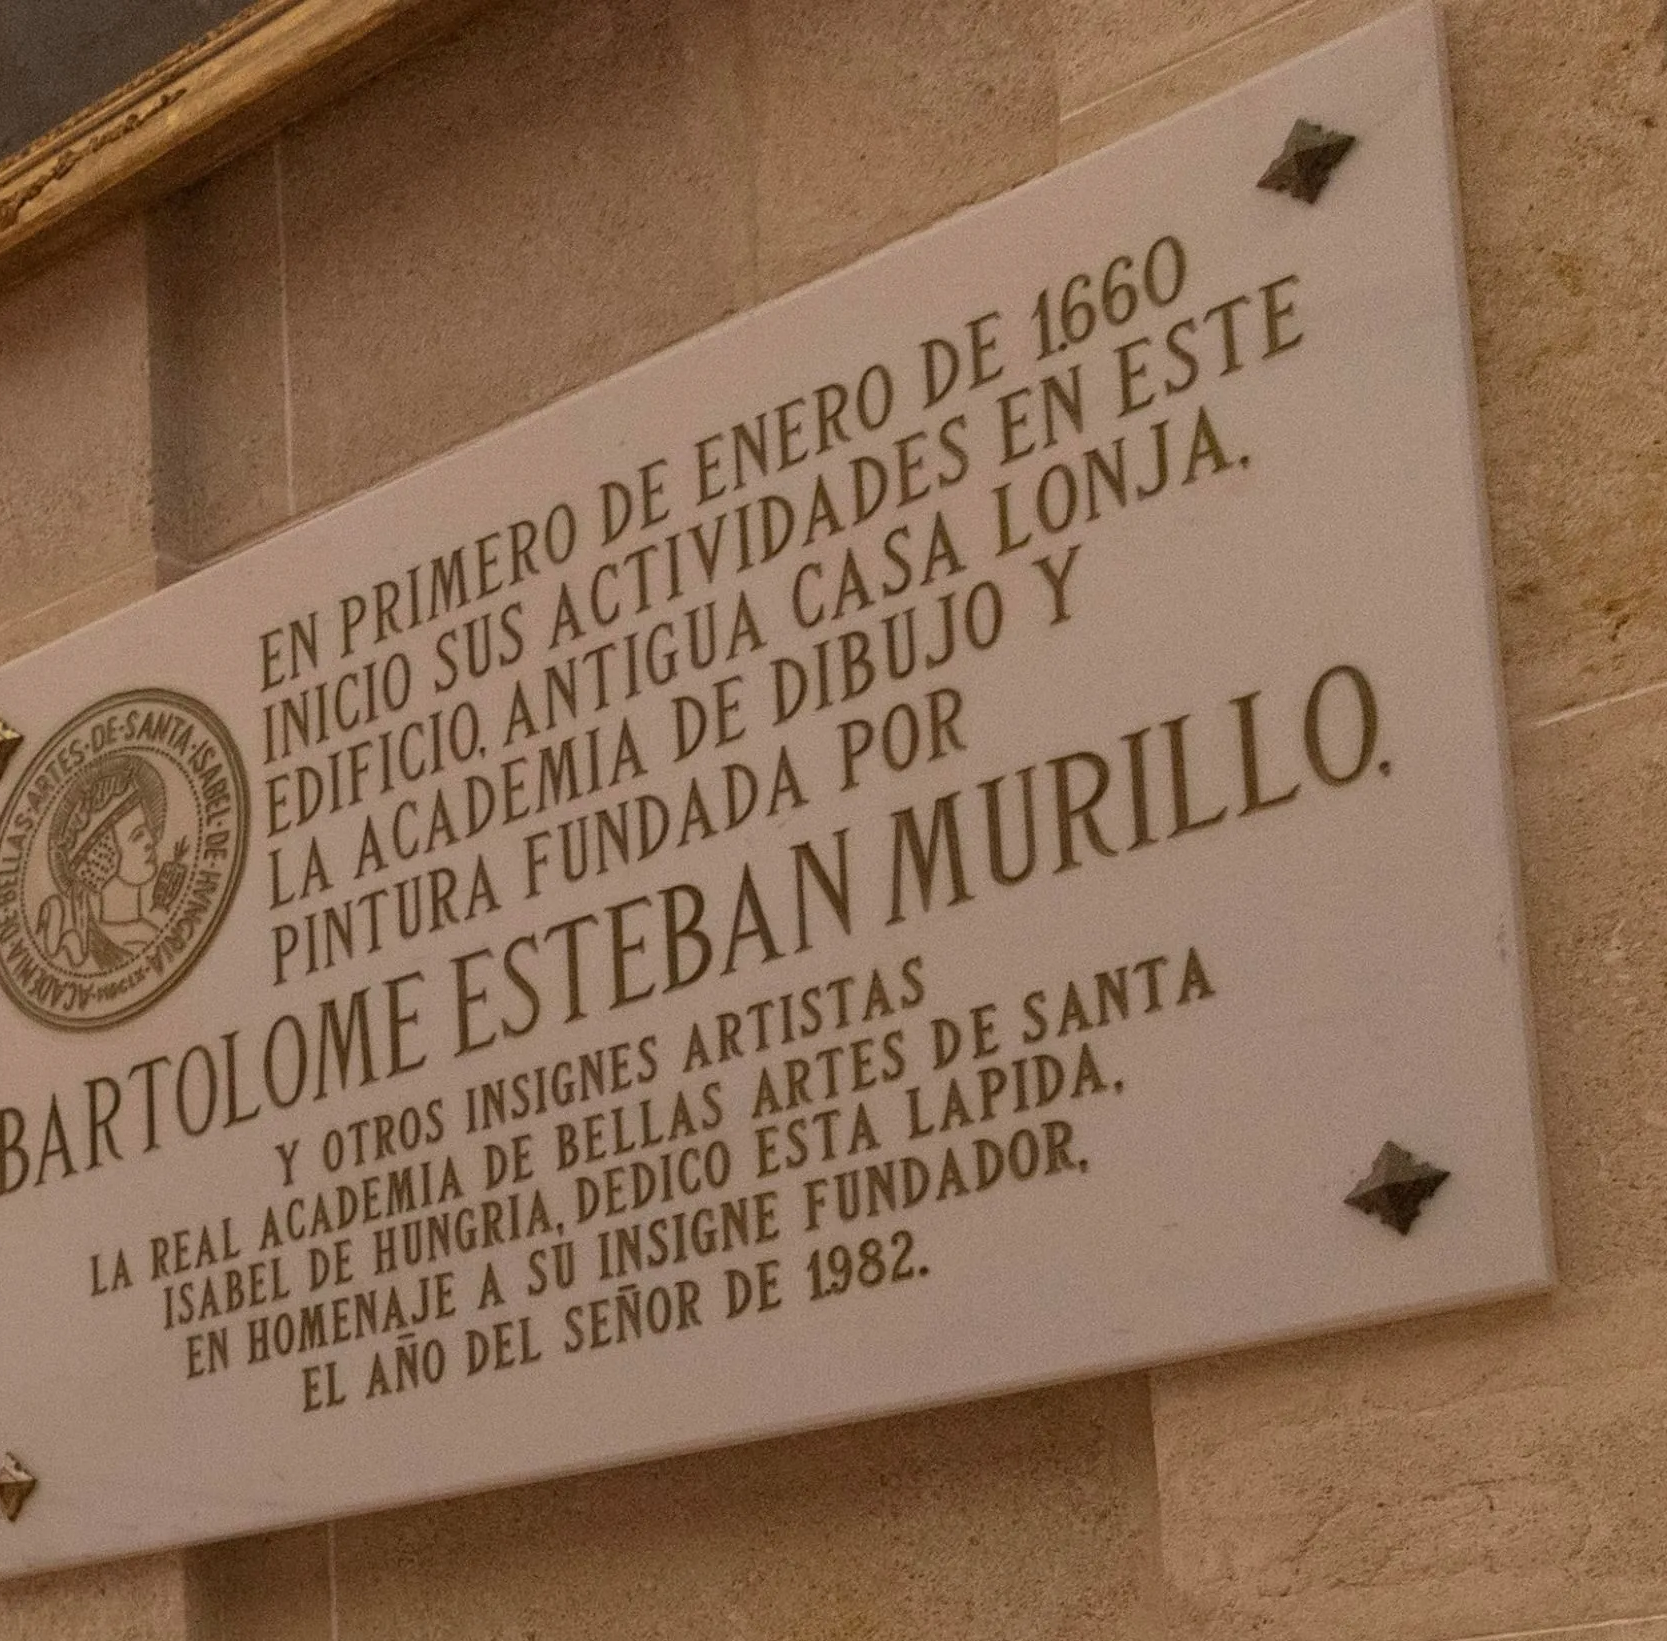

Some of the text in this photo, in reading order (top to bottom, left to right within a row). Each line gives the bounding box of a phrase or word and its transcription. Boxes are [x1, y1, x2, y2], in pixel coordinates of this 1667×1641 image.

[259, 611, 318, 692] EN
[339, 503, 576, 659] PRIMERO
[600, 458, 669, 546] DE
[695, 364, 893, 504] ENERO
[921, 312, 1003, 408] DE
[263, 274, 1304, 764] INICIO SUS ACTIVIDADES EN ESTE
[268, 545, 1081, 910] LA ACADEMIA DE DIBUJO Y
[503, 590, 767, 746] ANTIGUA
[792, 511, 967, 629] CASA
[271, 688, 967, 986] PINTURA FUNDADA POR
[451, 827, 851, 1058] ESTEBAN
[90, 946, 1216, 1297] LA REAL ACADEMIA DE BELLAS ARTES DE SANTA
[275, 956, 925, 1187] Y OTROS INSIGNES ARTISTAS
[163, 1257, 290, 1331] ISABEL
[309, 1239, 353, 1292] DE
[576, 1140, 731, 1225] DEDICO
[755, 1102, 882, 1178] ESTA
[187, 1328, 229, 1379] EN
[247, 1272, 457, 1364] HOMENAJE
[478, 1262, 506, 1310] A
[528, 1241, 576, 1297] SU
[598, 1191, 780, 1281] INSIGNE
[302, 1362, 347, 1413] EL
[366, 1332, 446, 1399] AÑO
[466, 1317, 542, 1377] DEL
[565, 1280, 702, 1353] SEÑOR
[724, 1259, 782, 1319] DE
